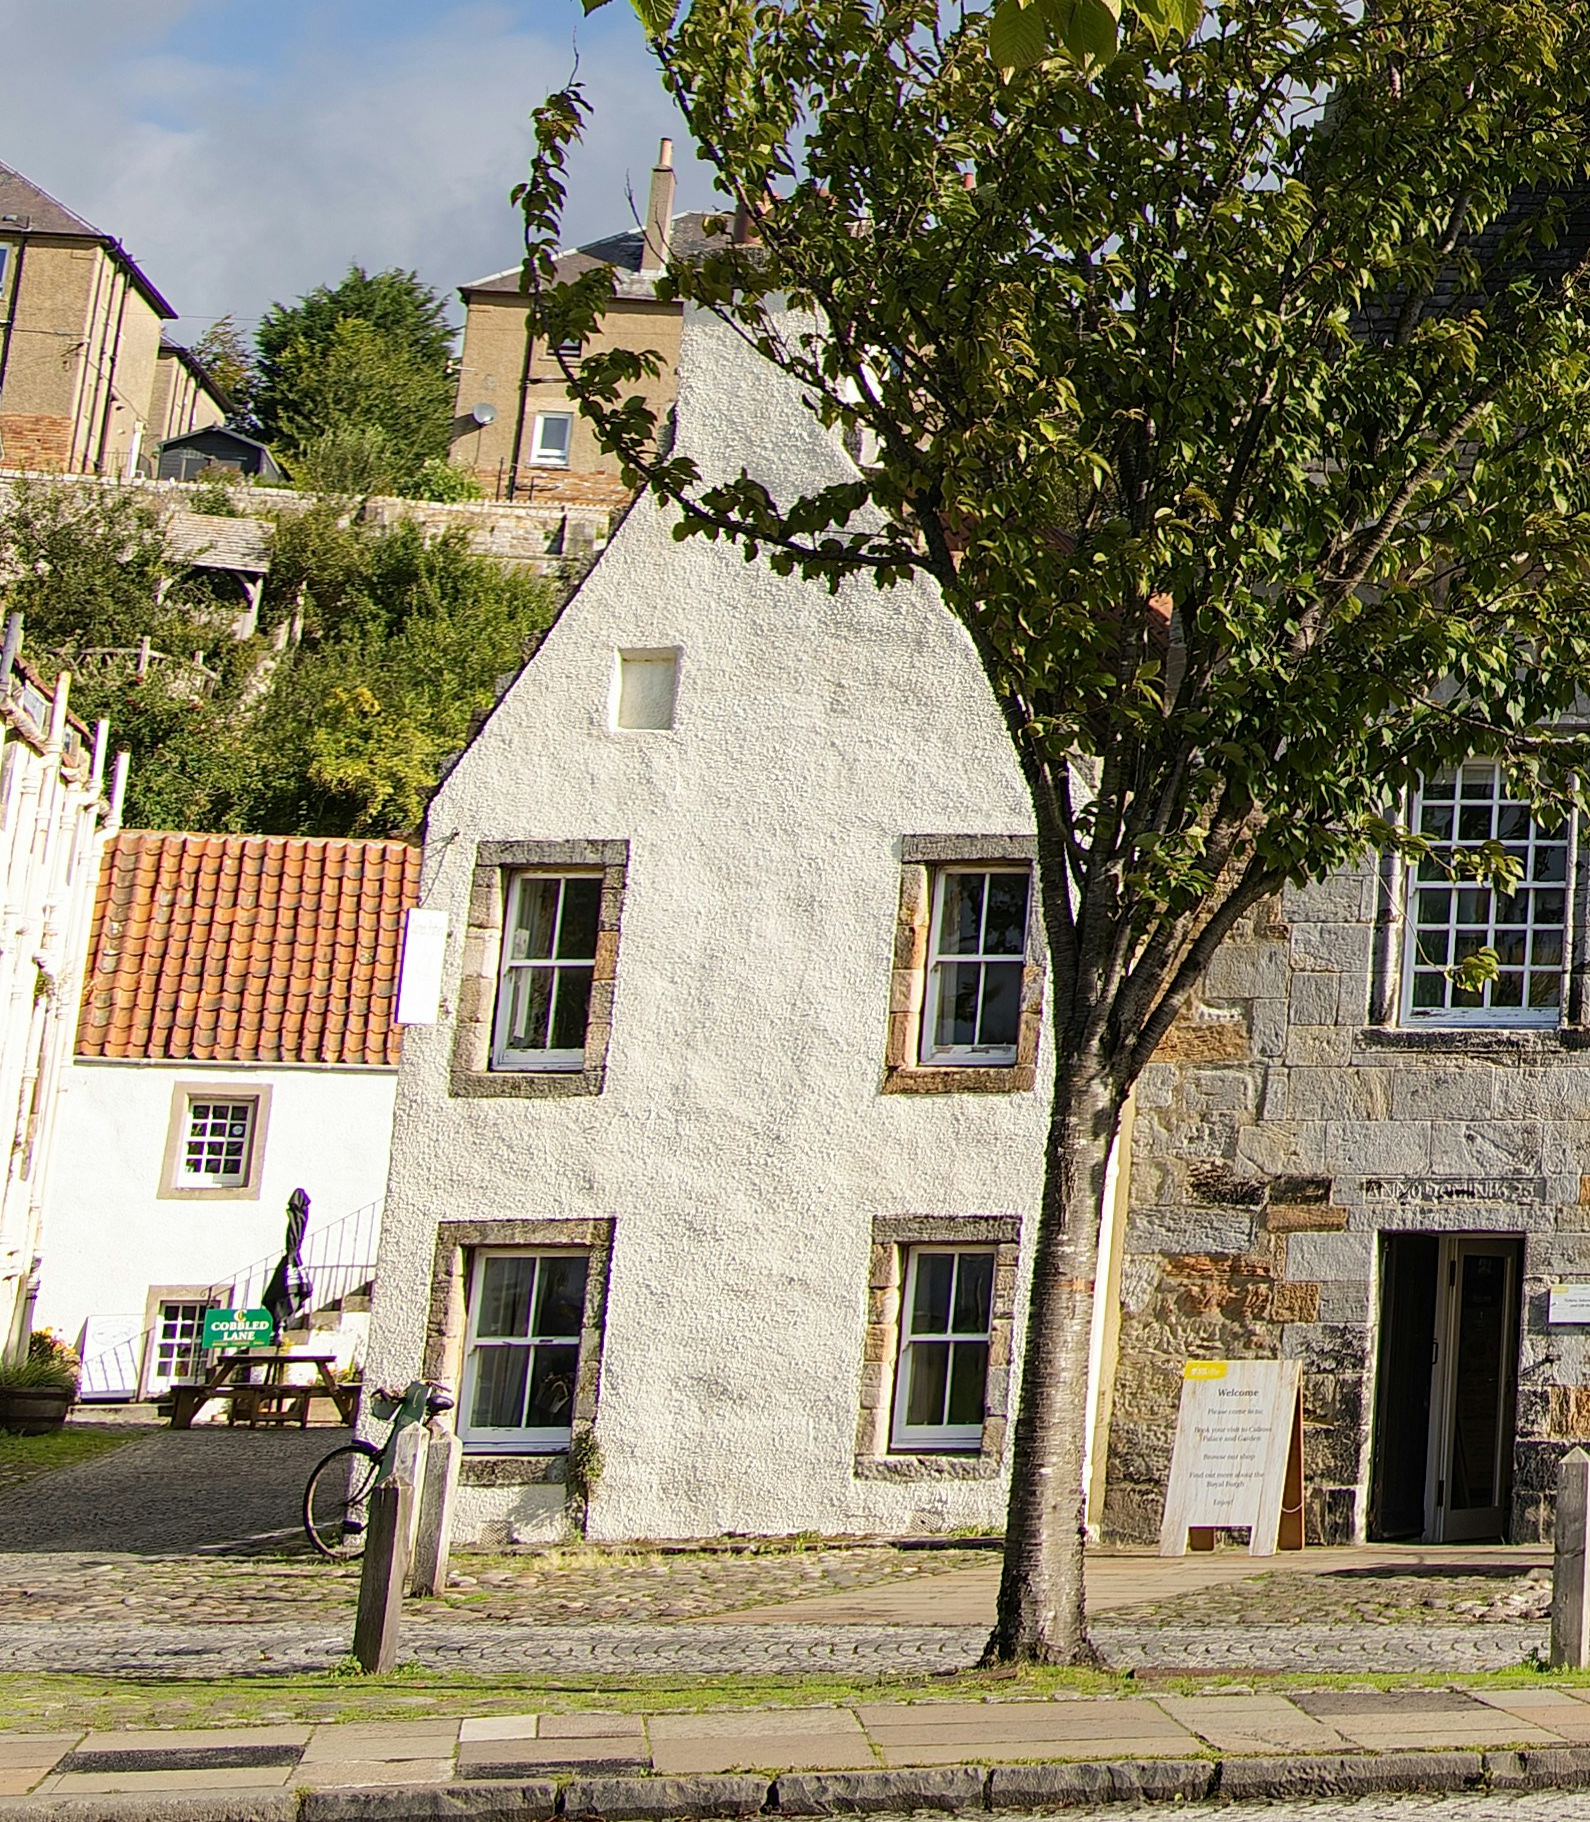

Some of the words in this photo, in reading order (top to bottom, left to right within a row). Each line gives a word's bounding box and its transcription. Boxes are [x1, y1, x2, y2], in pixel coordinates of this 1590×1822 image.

[211, 1321, 269, 1331] COBBLED
[223, 1331, 255, 1341] LANE
[1218, 1388, 1259, 1397] Welcome
